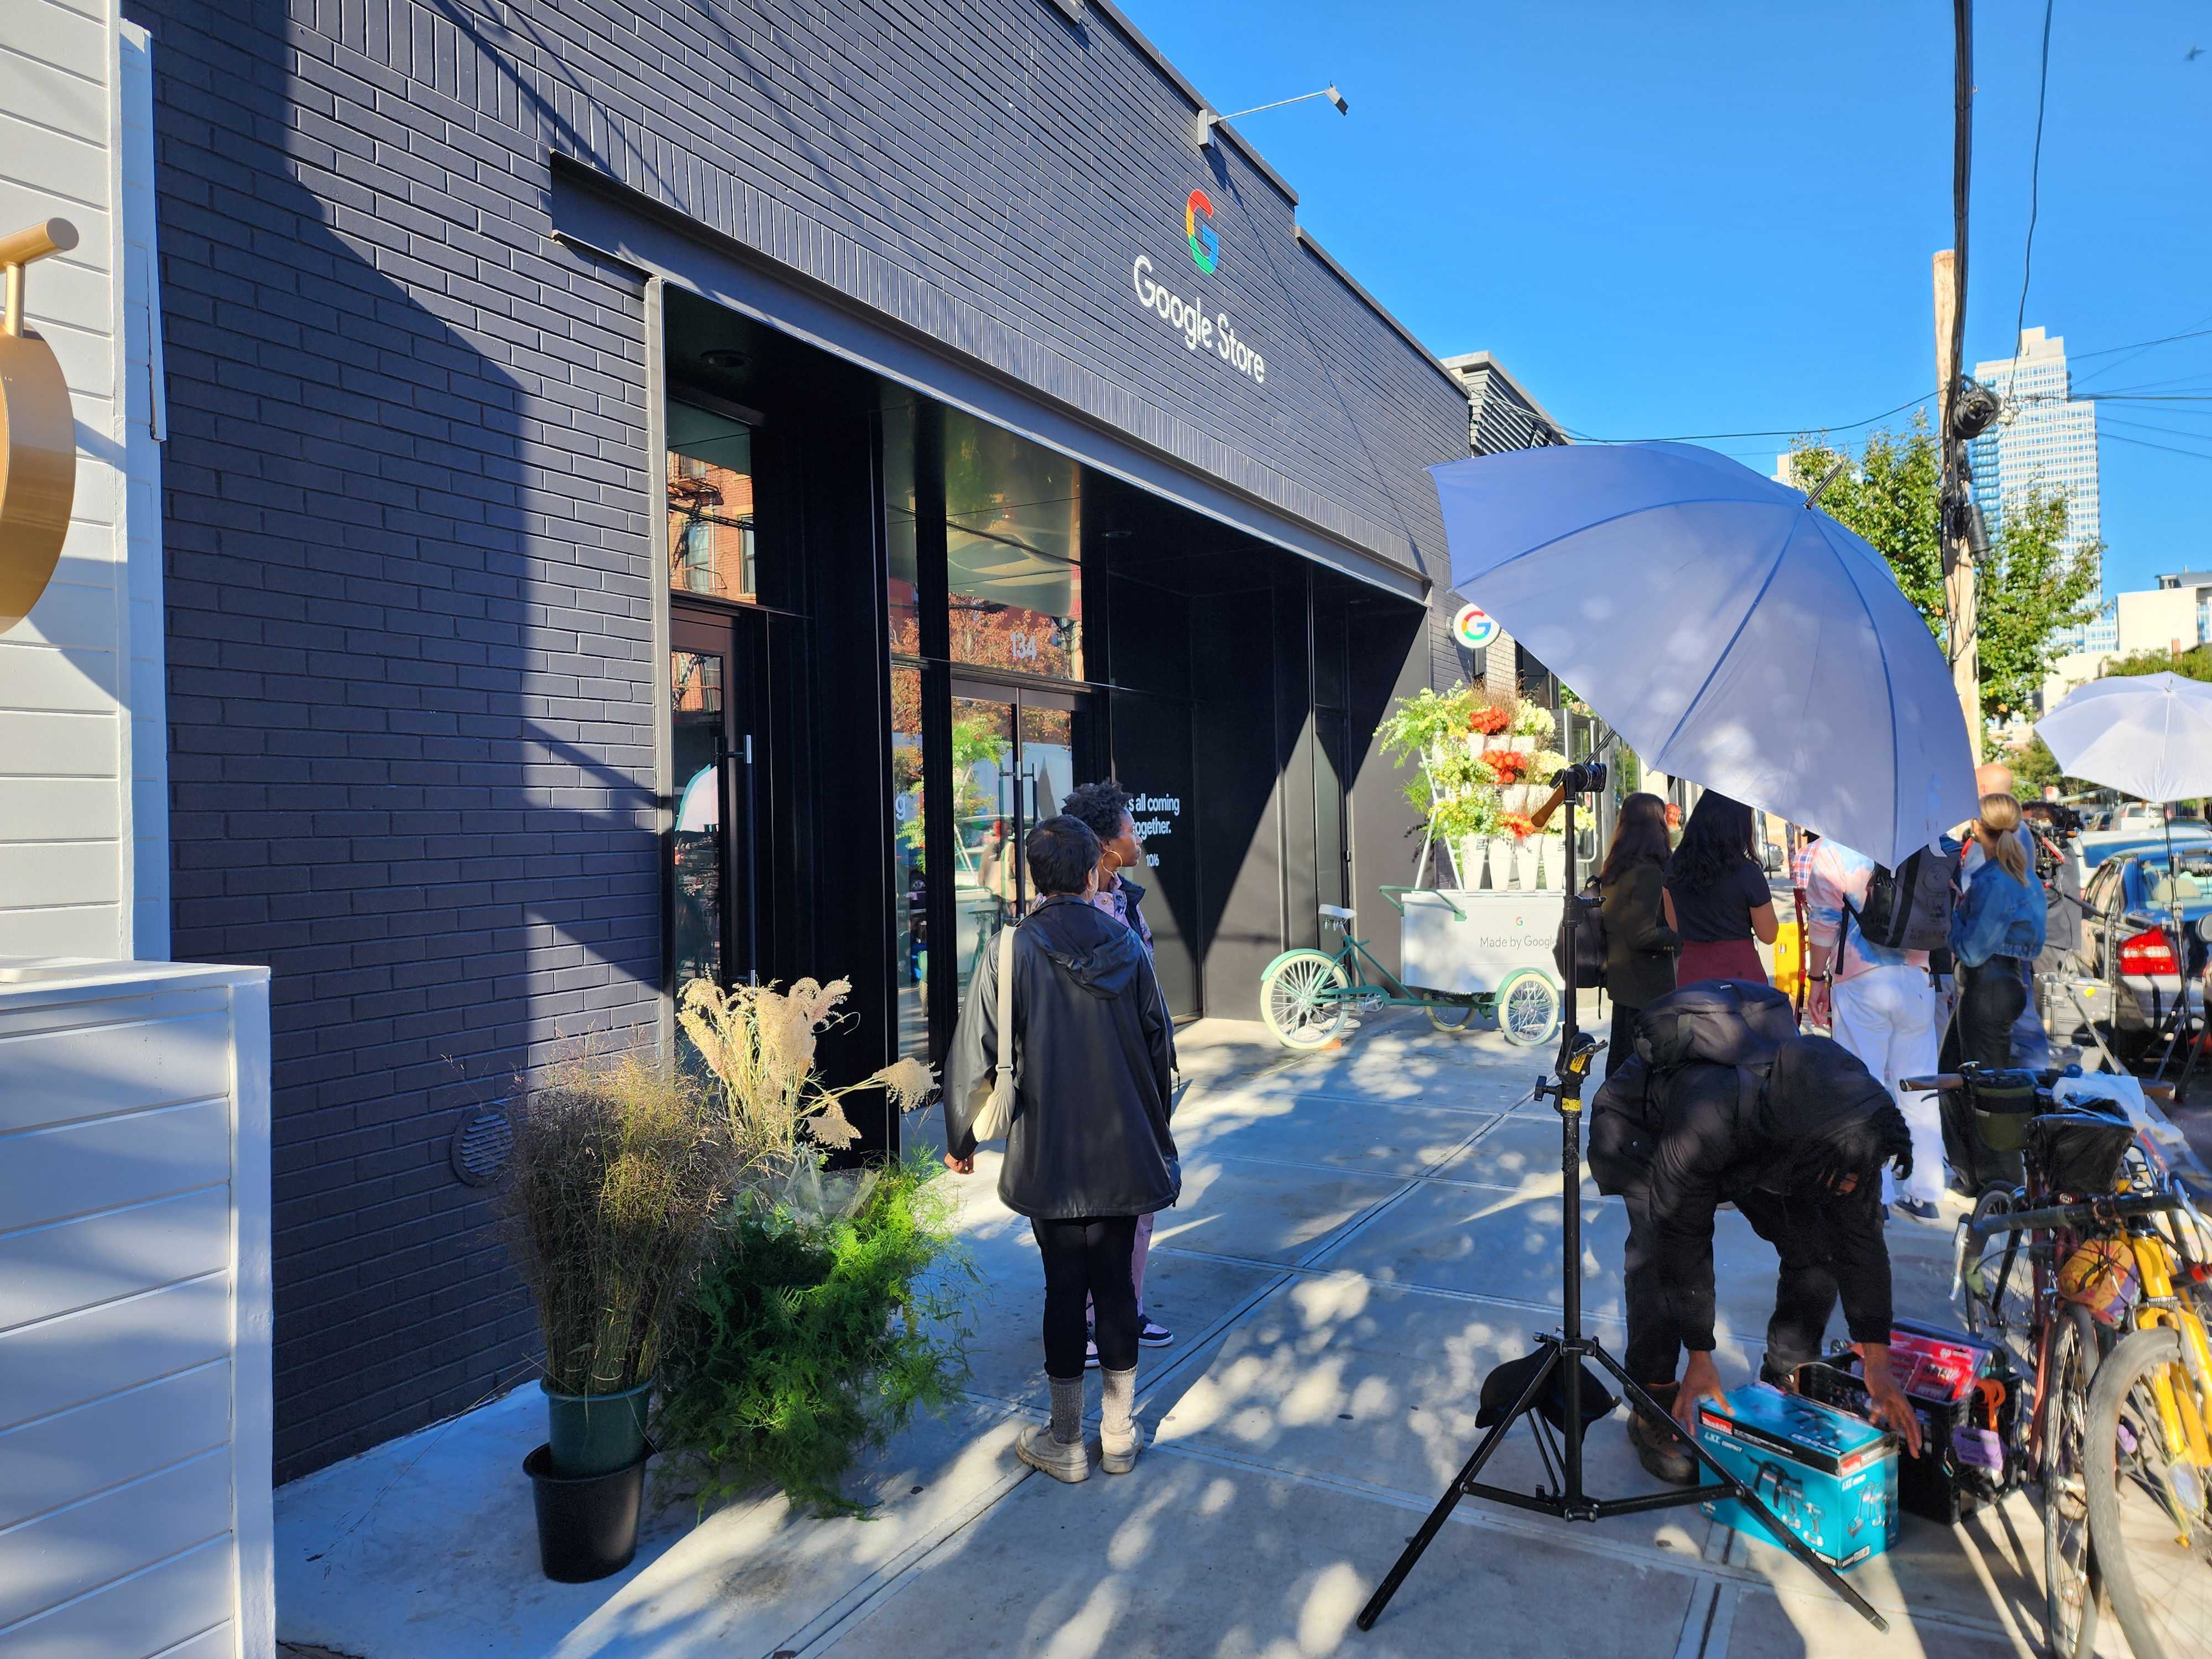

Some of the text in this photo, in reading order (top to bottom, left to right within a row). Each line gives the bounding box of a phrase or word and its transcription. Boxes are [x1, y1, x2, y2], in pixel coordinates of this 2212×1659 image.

[1133, 255, 1266, 383] Google Store
[1010, 631, 1037, 660] 134
[1135, 793, 1146, 812] all
[1147, 793, 1180, 816] coming
[1146, 853, 1160, 867] 10/6
[1480, 936, 1507, 947] Made
[1510, 935, 1521, 951] by
